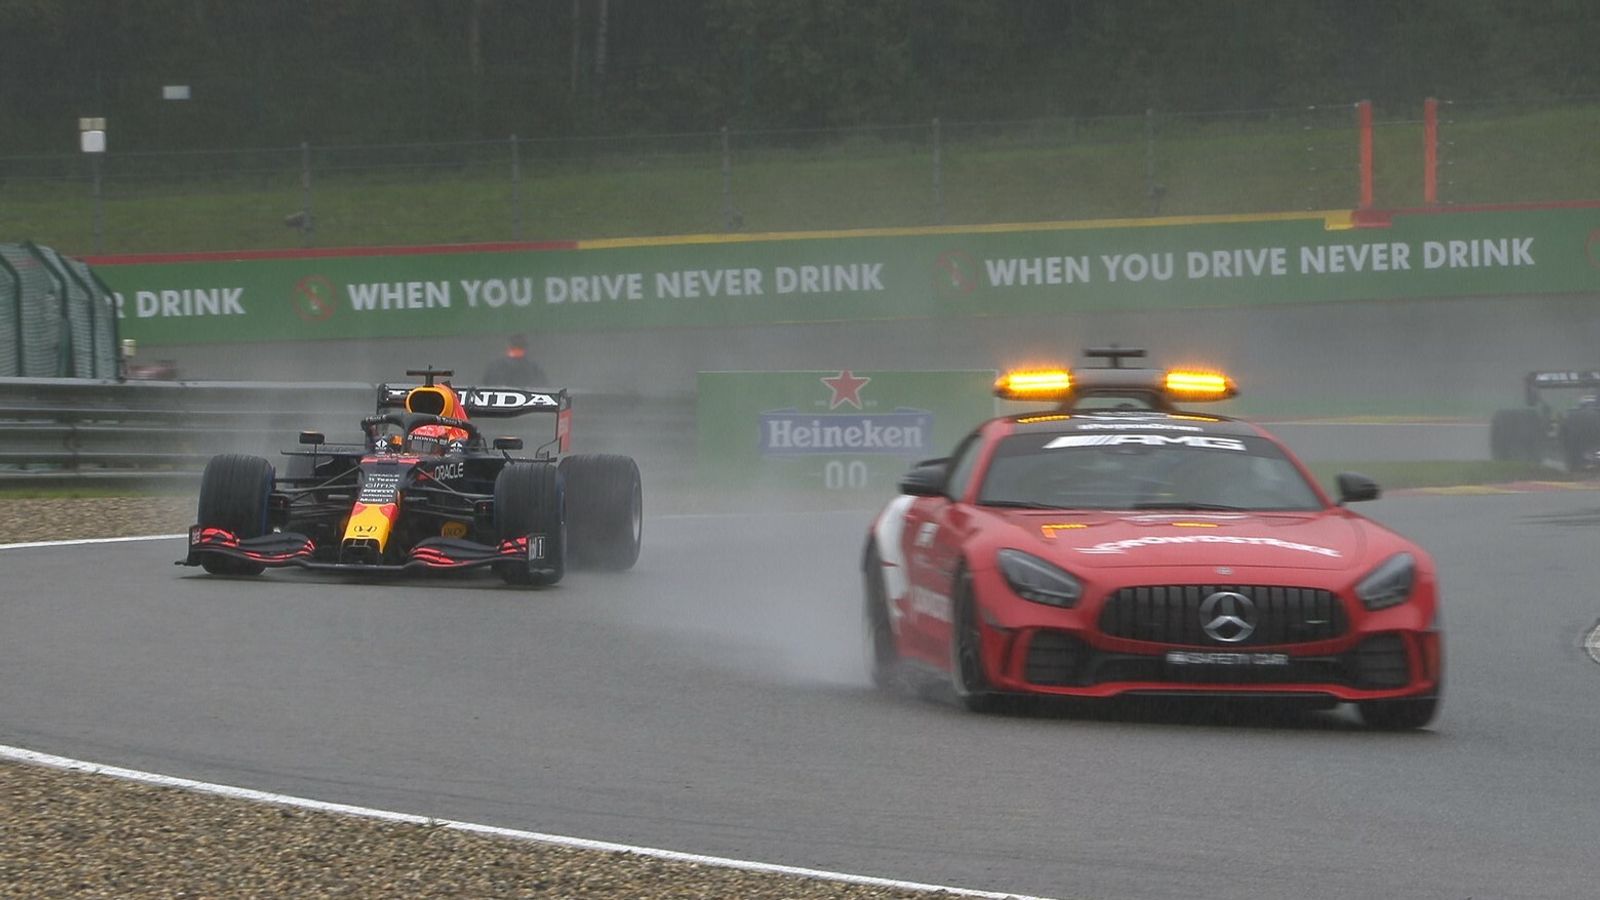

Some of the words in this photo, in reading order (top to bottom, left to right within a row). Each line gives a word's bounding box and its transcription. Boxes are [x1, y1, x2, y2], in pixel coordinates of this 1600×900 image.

[985, 255, 1091, 287] WHEN
[1102, 251, 1175, 283] YOU
[1187, 246, 1288, 280] DRIVE
[1300, 241, 1411, 275] NEVER
[1423, 236, 1536, 271] DRINK
[347, 281, 451, 312] WHEN
[461, 277, 534, 308] YOU
[545, 272, 643, 305] DRIVE
[656, 266, 764, 299] NEVER
[775, 261, 884, 294] DRINK
[136, 287, 247, 319] DRINK
[767, 418, 924, 449] Heineken
[1113, 434, 1248, 451] AMG
[434, 462, 464, 481] ORACLE
